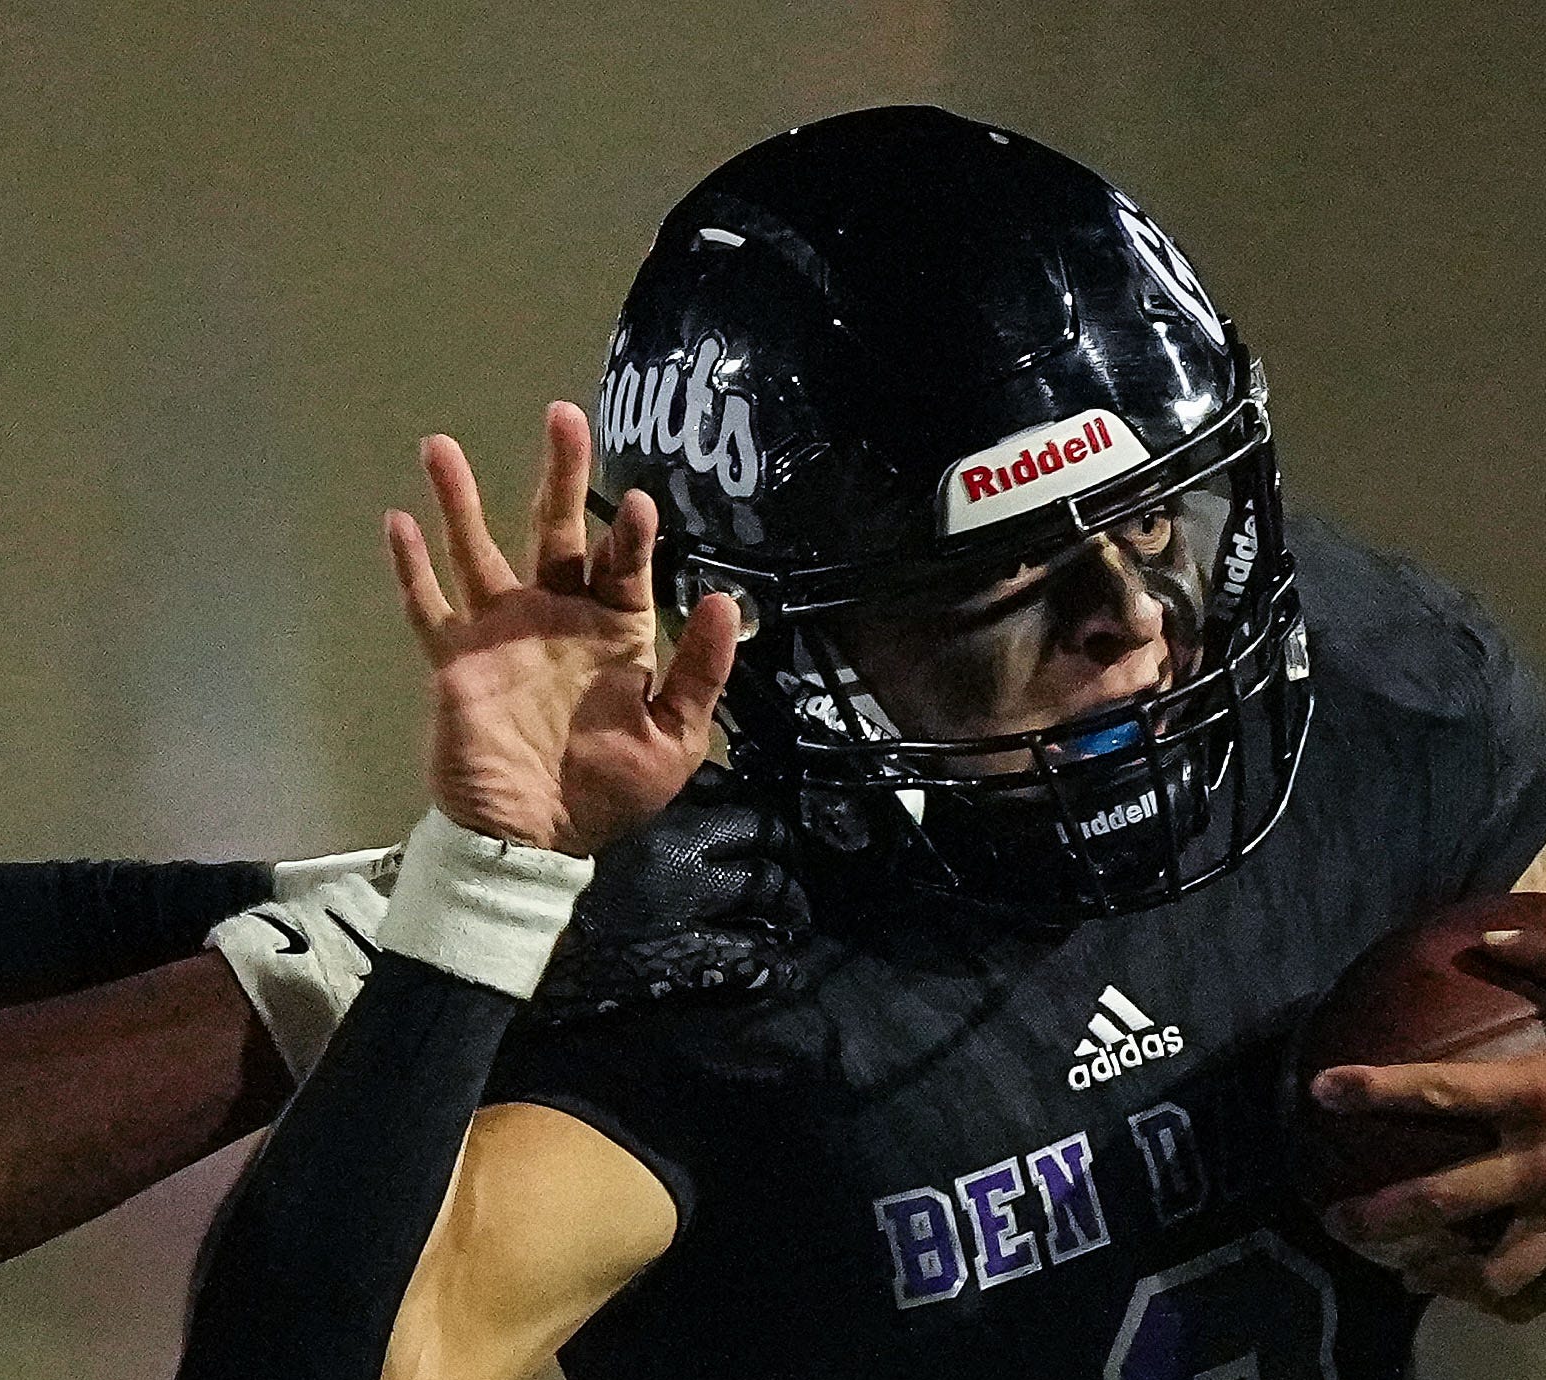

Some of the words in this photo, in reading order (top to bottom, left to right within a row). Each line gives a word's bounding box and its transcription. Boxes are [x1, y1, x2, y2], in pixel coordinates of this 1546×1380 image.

[603, 329, 758, 498] iants
[961, 417, 1113, 504] Riddell
[1068, 1020, 1185, 1091] adidas
[875, 1131, 1111, 1310] BEN
